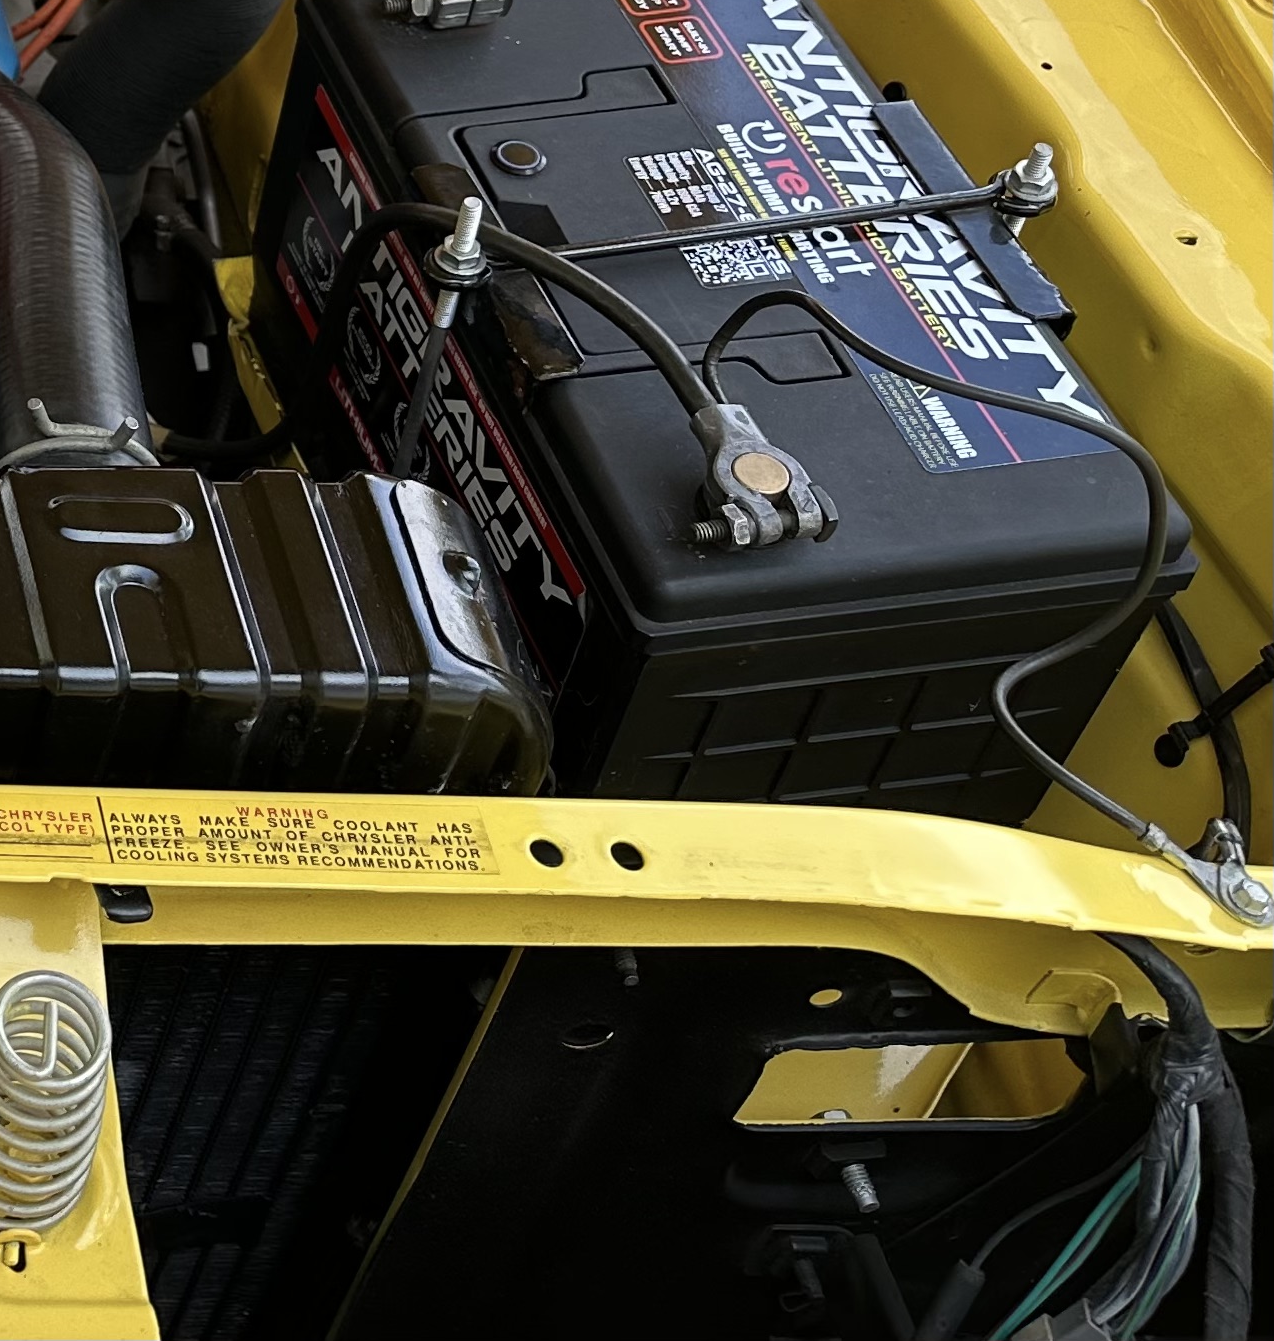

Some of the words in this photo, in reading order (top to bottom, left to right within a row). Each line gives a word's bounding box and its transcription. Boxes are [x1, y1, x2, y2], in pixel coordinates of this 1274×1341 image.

[654, 25, 682, 57] START
[669, 26, 693, 53] JUMP
[716, 123, 764, 178] BUILT-IN
[753, 174, 790, 215] JUMP
[741, 52, 821, 156] INTELLIGENT
[890, 266, 958, 350] BATTERY
[764, 157, 877, 277] resart
[920, 395, 978, 459] WARNING
[109, 813, 181, 825] ALWAYS
[199, 816, 250, 827] MAKE
[267, 817, 316, 829] SURE
[333, 819, 418, 833] COOLANT
[437, 822, 473, 834] HAS
[236, 806, 329, 820] WARNING
[42, 822, 95, 837] TYPE)
[111, 825, 185, 837] PROPER
[198, 828, 272, 840] AMOUNT
[286, 830, 308, 841] OF
[321, 831, 417, 845] CHRYSLER
[430, 834, 477, 846] ANTI-
[114, 837, 191, 850] FREEZE.
[206, 840, 241, 851] SEE
[256, 841, 340, 854] OWNER'S
[355, 844, 430, 857] MANUAL
[445, 847, 481, 859] FOR
[117, 849, 199, 862] COOLING
[206, 852, 290, 866] SYSTEMS
[298, 855, 486, 872] RECOMMENDATIONS.
